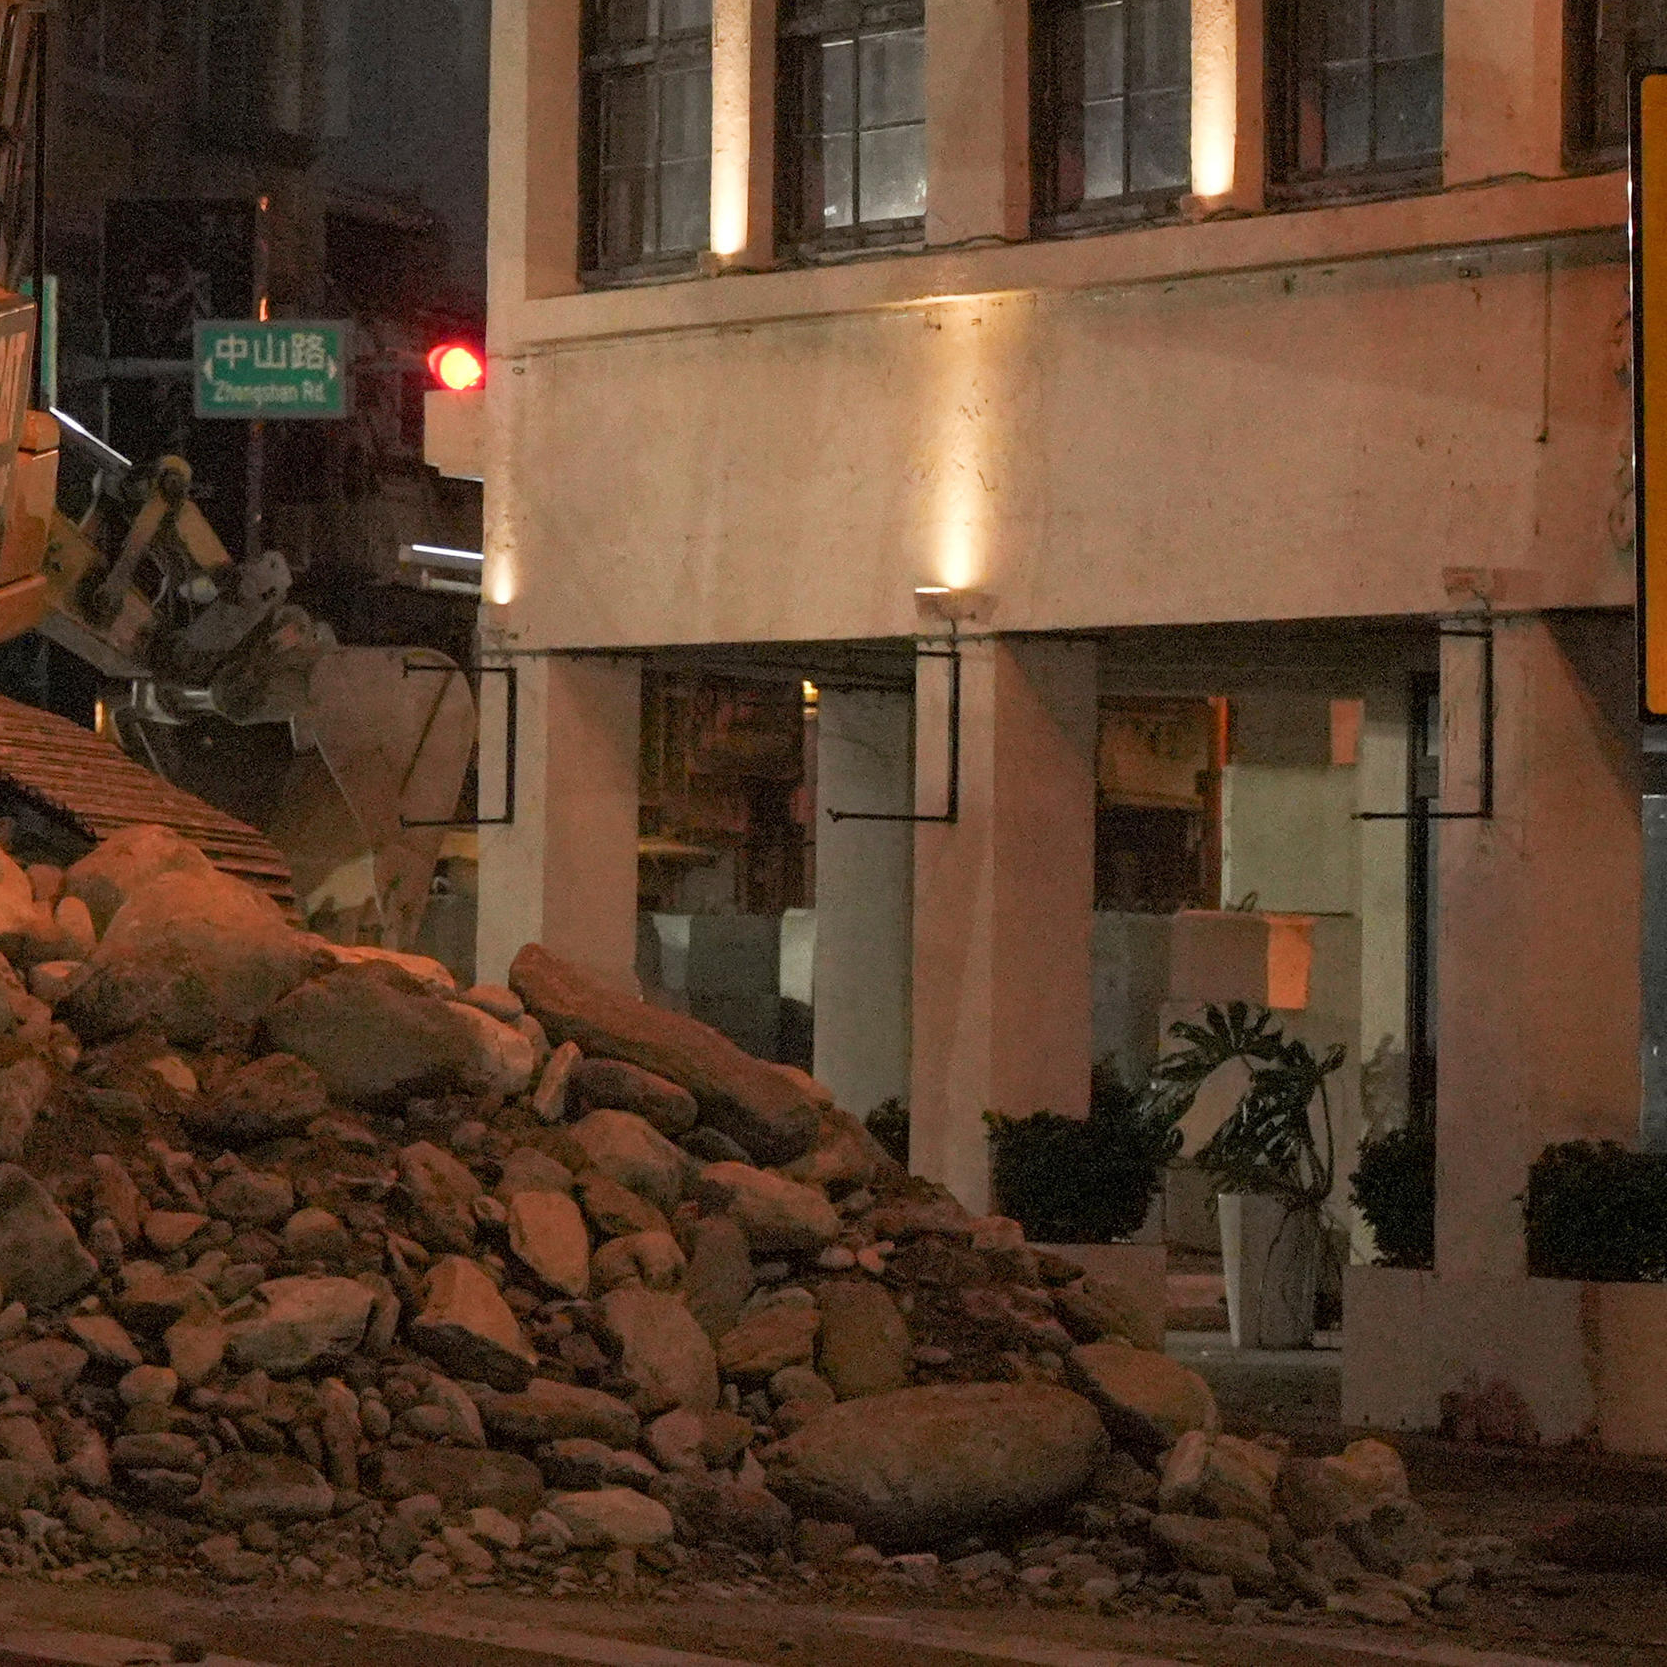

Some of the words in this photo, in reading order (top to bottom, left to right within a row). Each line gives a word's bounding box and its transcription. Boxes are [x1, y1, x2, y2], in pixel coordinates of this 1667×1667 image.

[213, 331, 327, 371] 中山路
[212, 378, 300, 409] Zhongshan
